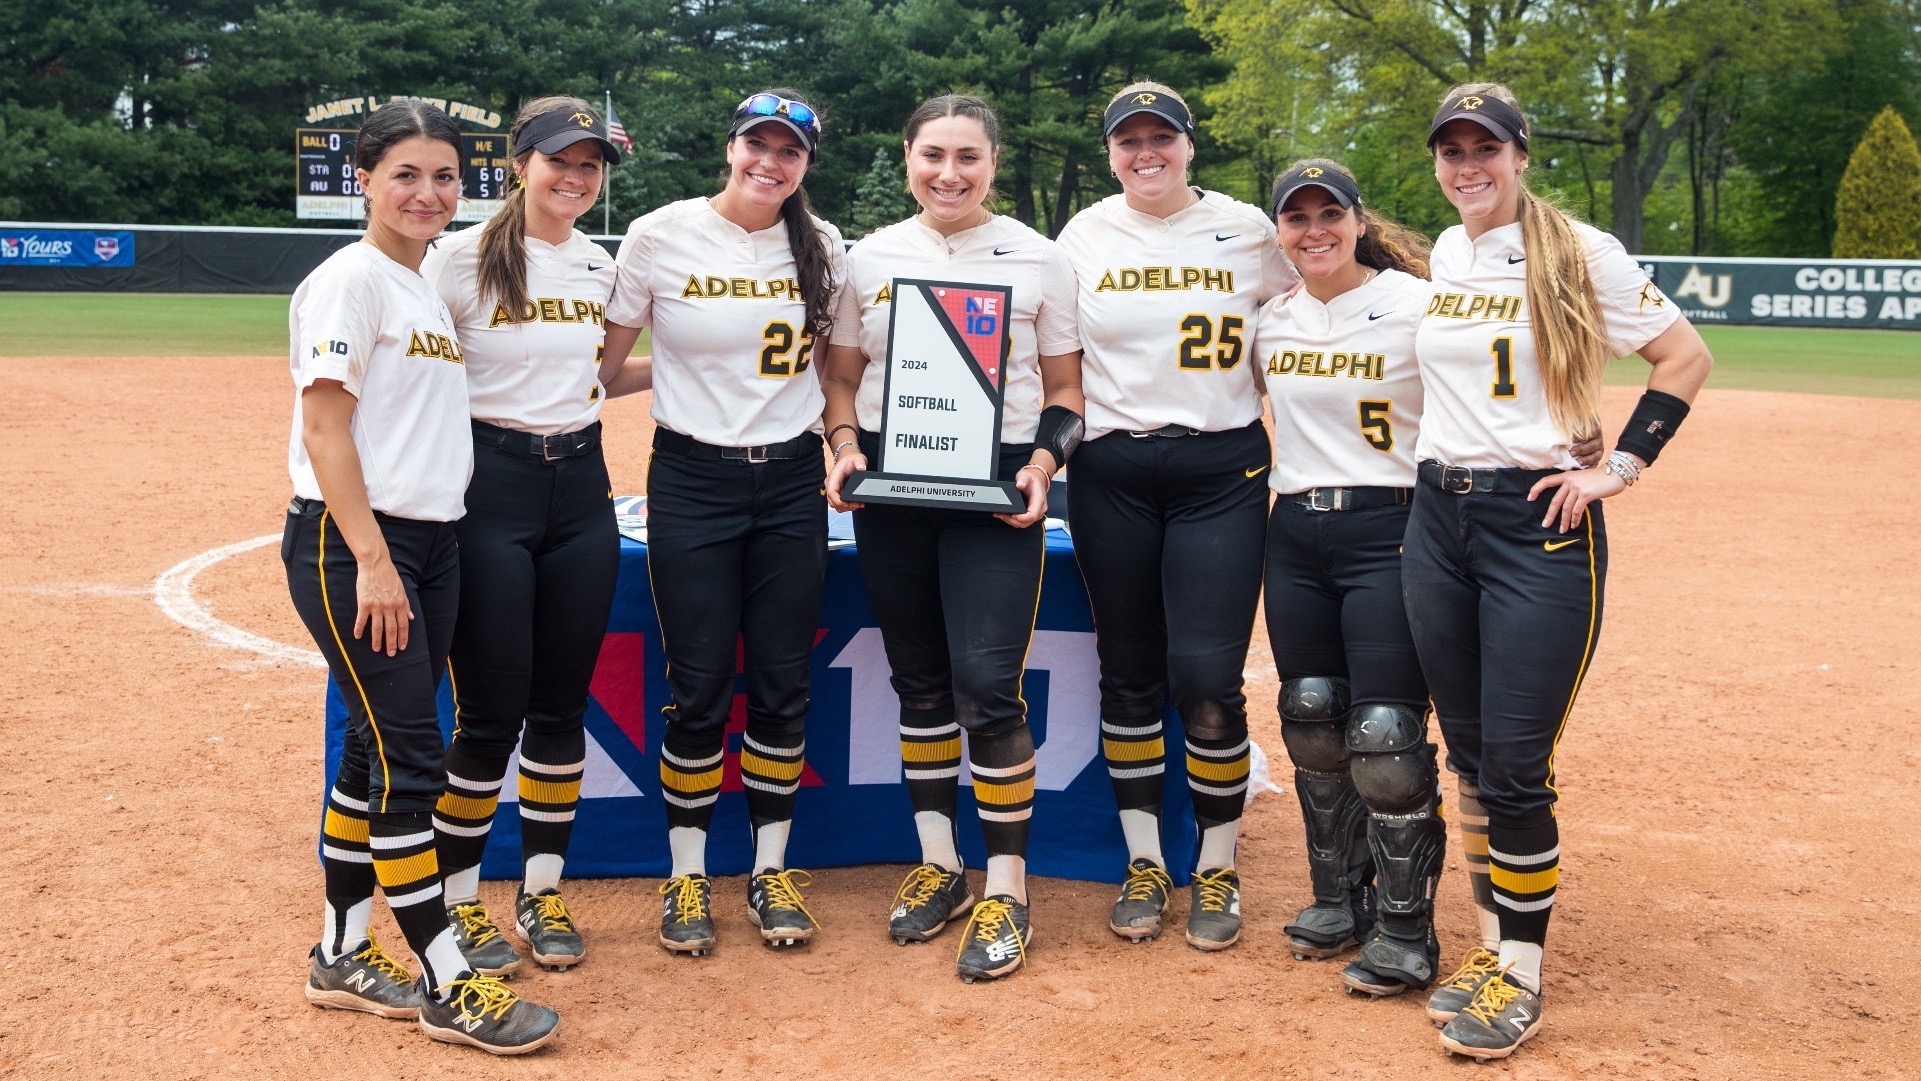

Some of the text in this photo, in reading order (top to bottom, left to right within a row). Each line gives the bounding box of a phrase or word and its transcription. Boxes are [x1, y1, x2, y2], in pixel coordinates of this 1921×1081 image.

[305, 97, 364, 123] JANET
[449, 101, 501, 128] FIELD
[302, 133, 340, 151] BALL 0
[475, 141, 493, 152] H/E
[308, 164, 330, 175] STA
[480, 168, 489, 181] 6
[494, 168, 504, 181] 0
[310, 181, 328, 192] AU
[302, 201, 348, 210] ADELPHI
[1095, 267, 1234, 293] ADELPHI
[1675, 264, 1732, 308] AU
[1795, 267, 1921, 293] COLLEG
[965, 296, 999, 315] NE
[1751, 294, 1867, 319] SERIES
[966, 315, 996, 336] 10
[1178, 312, 1244, 371] 25
[901, 360, 928, 370] 2024
[1267, 350, 1385, 380] ADELPHI
[1490, 336, 1517, 398] 1
[898, 395, 957, 411] SOFTBALL
[1357, 398, 1394, 453] 5
[895, 433, 958, 452] FINALIST
[890, 485, 976, 497] ADELPHI UNIVERSITY
